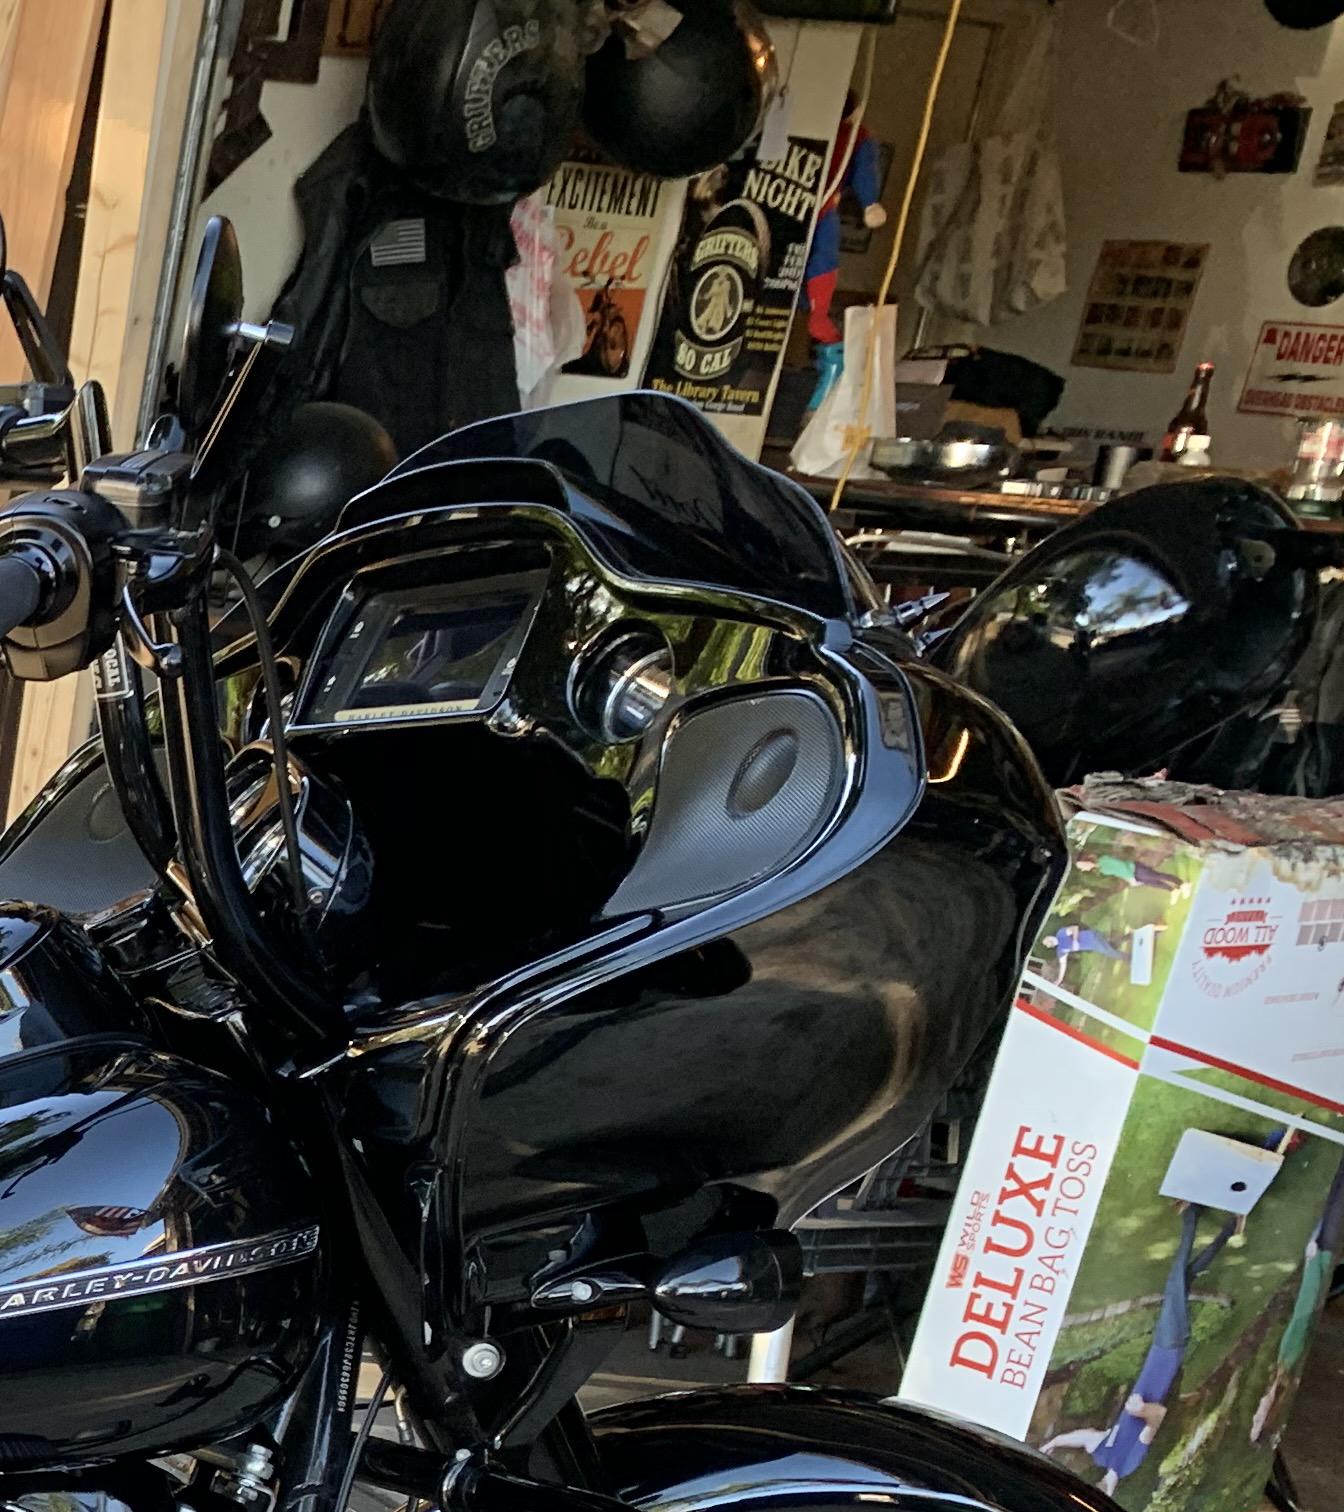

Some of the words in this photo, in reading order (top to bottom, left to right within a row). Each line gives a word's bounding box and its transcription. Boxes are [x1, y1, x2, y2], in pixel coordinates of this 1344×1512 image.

[546, 167, 663, 218] EXCITEMENT
[742, 168, 817, 221] NIGHT
[675, 342, 697, 372] SO
[699, 347, 733, 374] CAL
[1276, 329, 1344, 367] DANGER
[652, 378, 673, 392] The
[676, 380, 719, 402] Library
[721, 384, 761, 402] Tavern
[101, 643, 121, 688] OCAL
[1203, 926, 1250, 946] WOOD
[1254, 924, 1280, 943] ALL
[958, 1190, 981, 1249] WILD
[966, 1191, 990, 1252] SPORTS
[949, 1125, 1066, 1380] DELUXE
[1000, 1299, 1048, 1390] BEAN
[1029, 1225, 1072, 1296] BAG
[1051, 1140, 1097, 1217] TOSS
